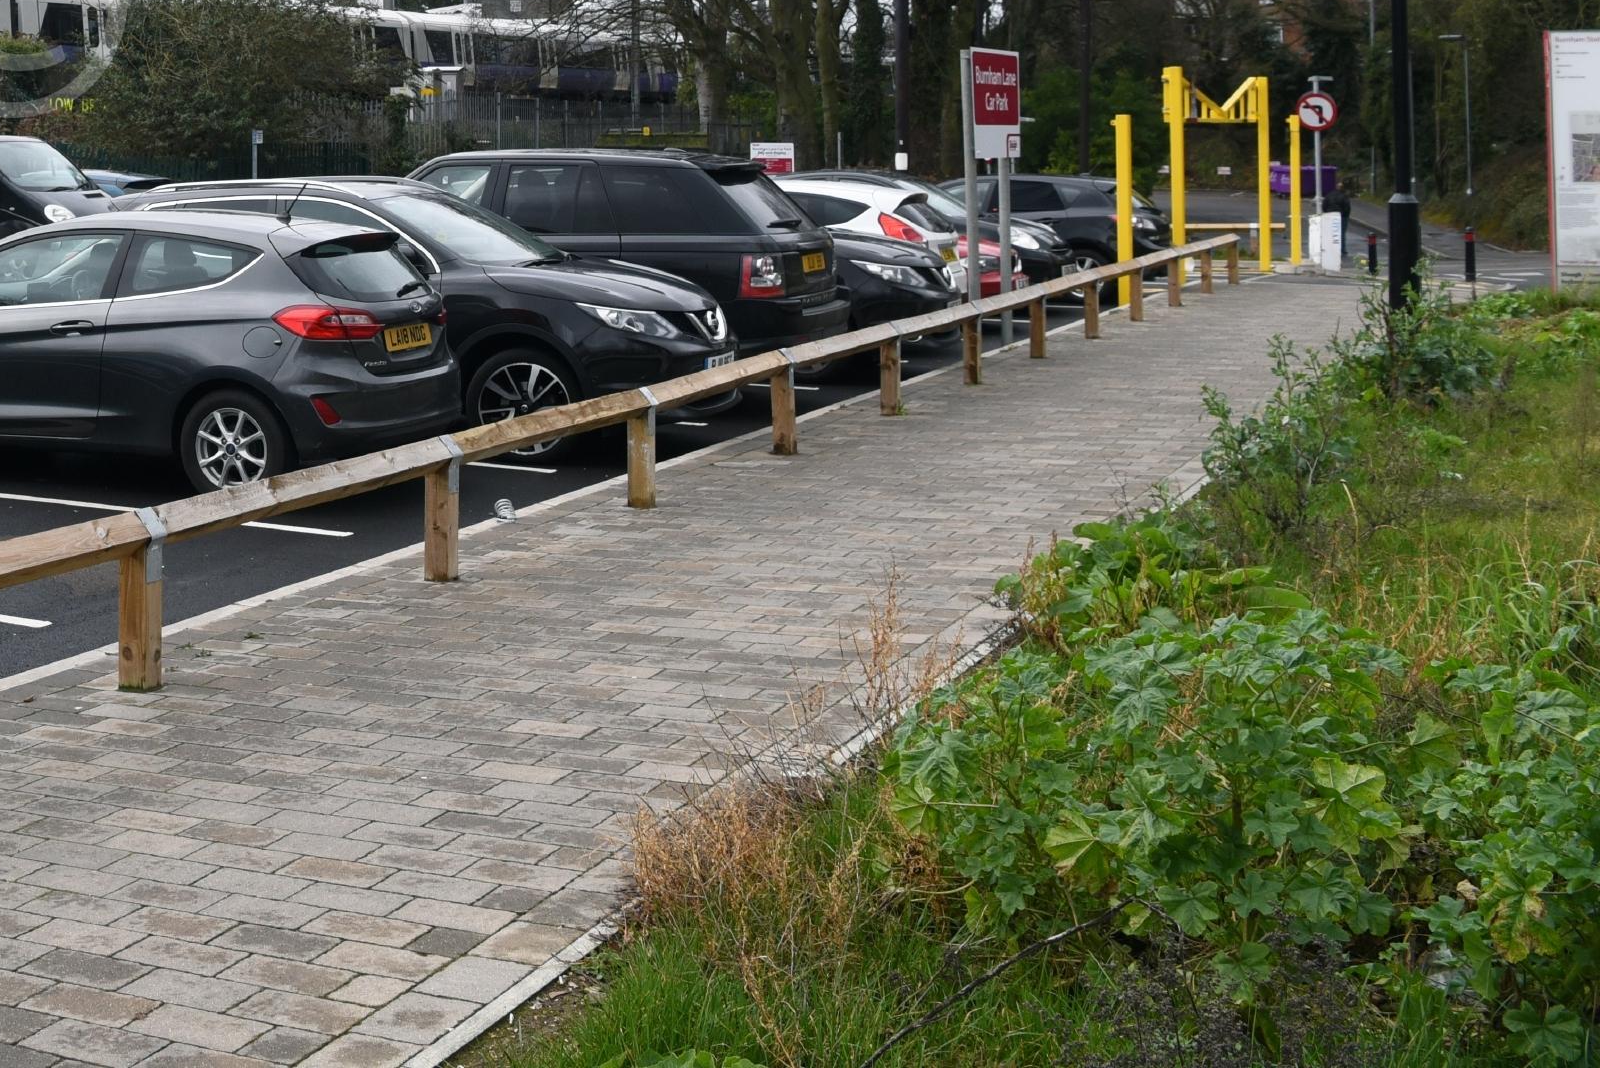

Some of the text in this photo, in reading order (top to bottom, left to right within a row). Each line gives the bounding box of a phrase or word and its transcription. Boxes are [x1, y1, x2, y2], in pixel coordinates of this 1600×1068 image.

[975, 65, 1017, 87] Burnham Lane
[49, 97, 74, 111] LOW
[985, 92, 1009, 111] Car Park
[389, 328, 410, 347] LA18
